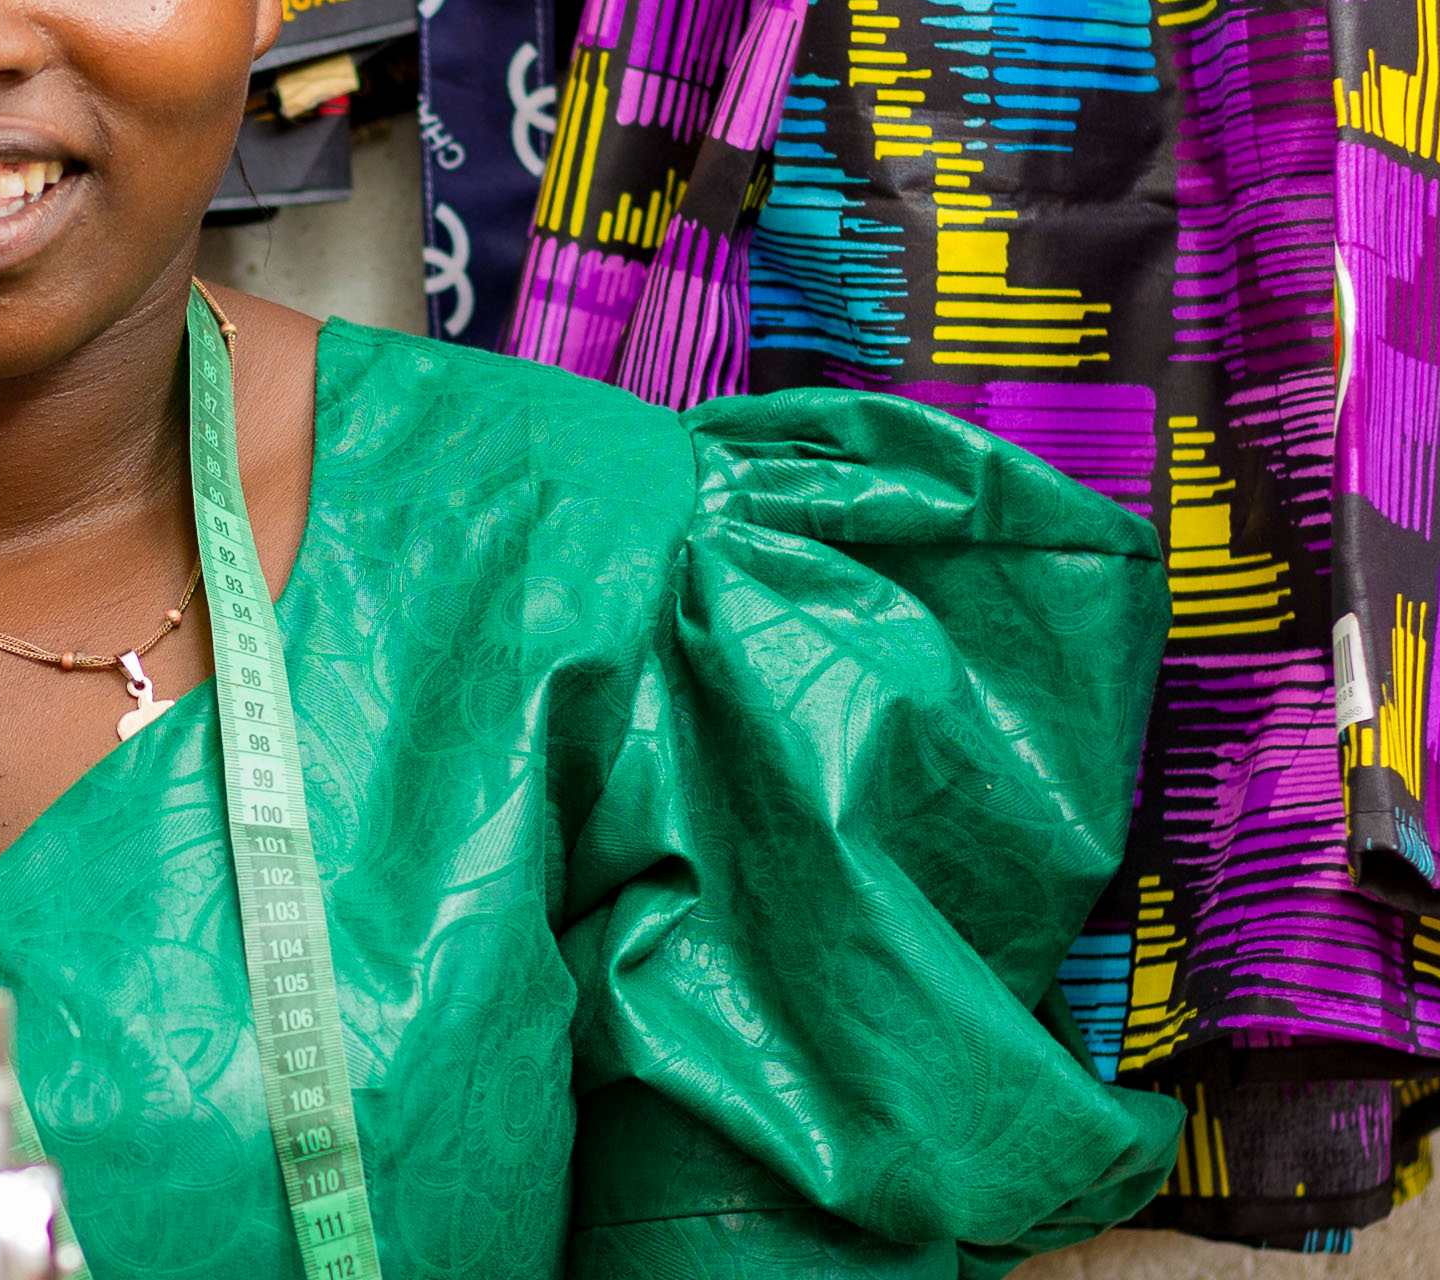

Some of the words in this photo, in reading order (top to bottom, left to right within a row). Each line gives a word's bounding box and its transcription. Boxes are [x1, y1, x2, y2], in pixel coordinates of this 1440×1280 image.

[204, 360, 217, 384] 86
[205, 391, 217, 414] 87
[209, 486, 226, 508] 90
[213, 516, 230, 537] 91
[219, 546, 237, 566] 92
[225, 574, 244, 595] 93
[232, 603, 252, 621] 94
[238, 633, 257, 653] 95
[241, 667, 262, 688] 96
[244, 701, 265, 720] 97
[248, 734, 270, 753] 98
[252, 768, 274, 788] 99
[251, 804, 282, 824] 100
[255, 837, 287, 854] 101
[260, 868, 294, 886] 102
[266, 901, 299, 921] 103
[269, 938, 304, 960] 104
[273, 973, 309, 994] 105
[278, 1008, 314, 1032] 106
[284, 1046, 318, 1072] 107
[290, 1086, 325, 1112] 108
[296, 1125, 332, 1155] 109
[307, 1168, 340, 1198] 110
[315, 1211, 346, 1240] 111
